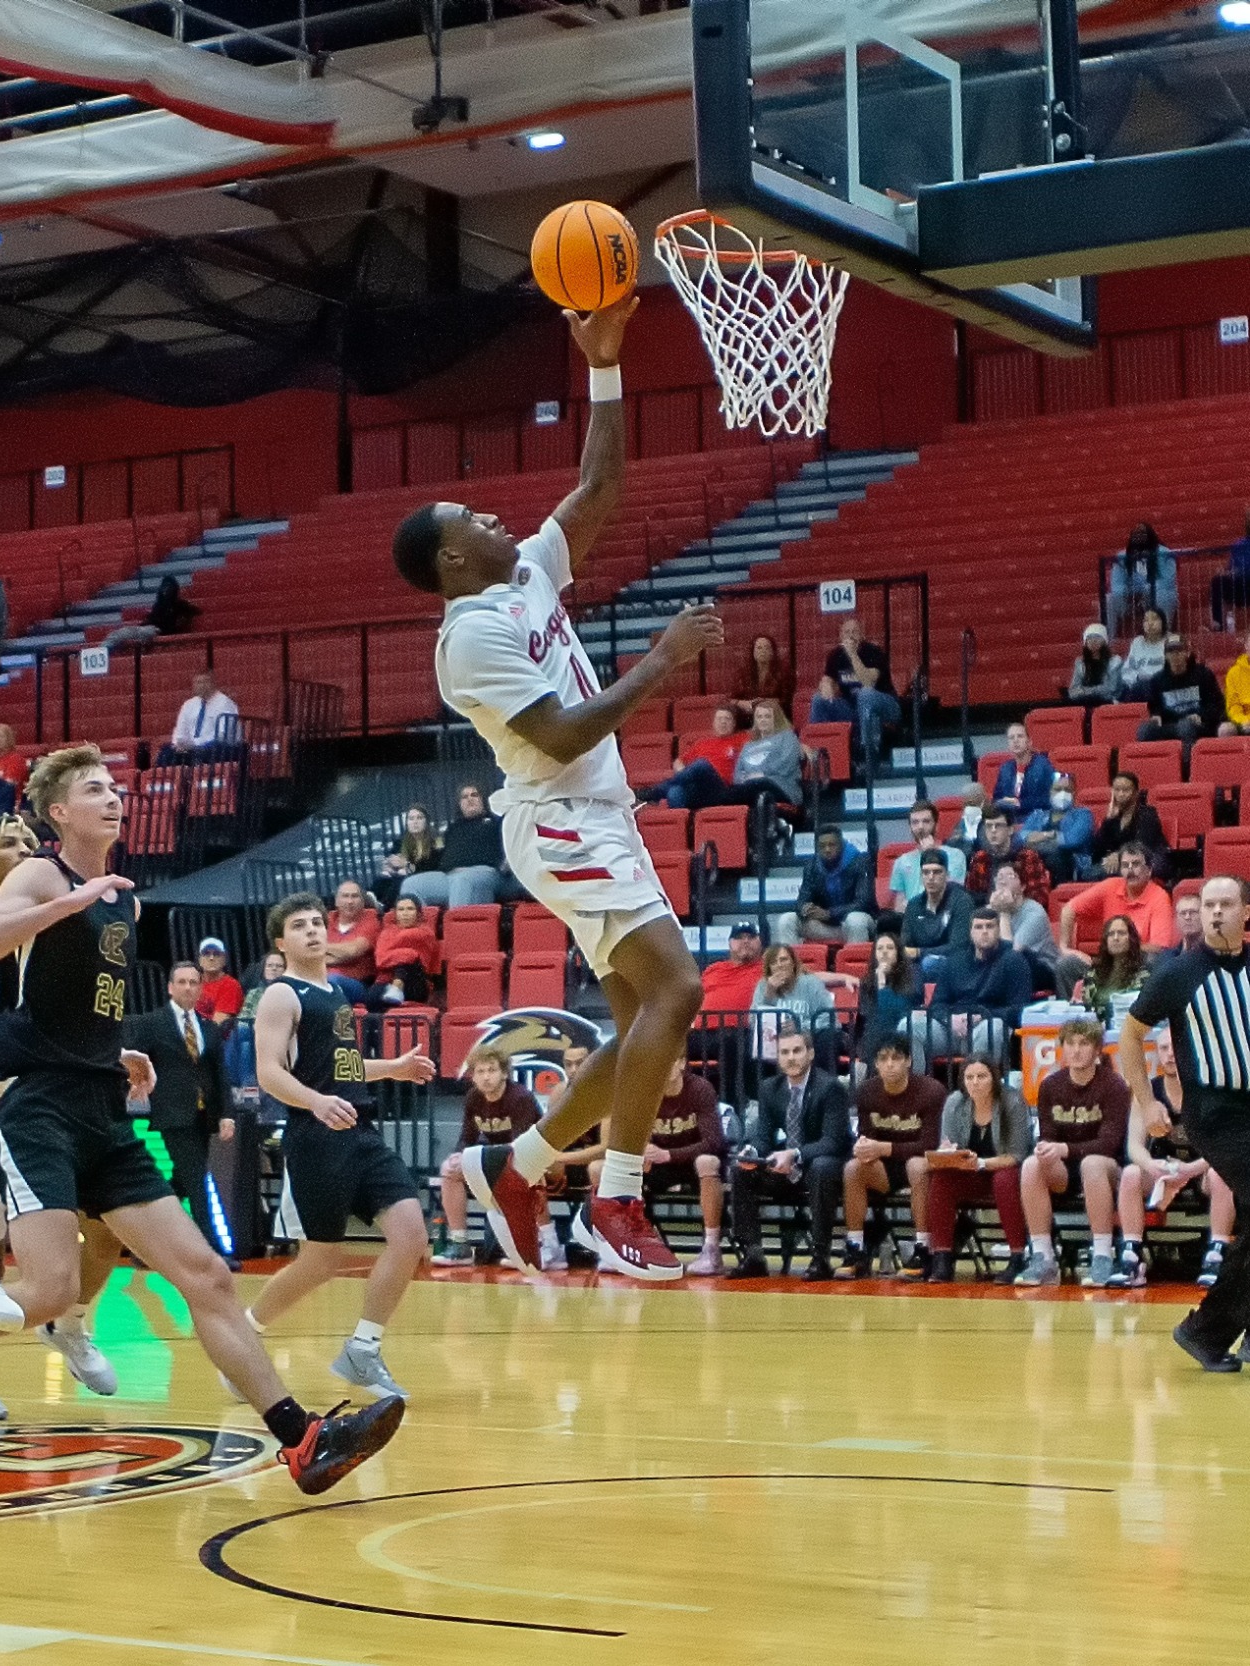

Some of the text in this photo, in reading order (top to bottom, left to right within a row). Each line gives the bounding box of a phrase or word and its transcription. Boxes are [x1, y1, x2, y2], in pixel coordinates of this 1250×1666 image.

[606, 234, 627, 284] NCAA
[1223, 322, 1246, 336] 204
[823, 586, 852, 605] 104
[83, 653, 105, 669] 103
[93, 972, 125, 1021] 24
[1036, 1040, 1056, 1064] G
[334, 1047, 363, 1082] 20
